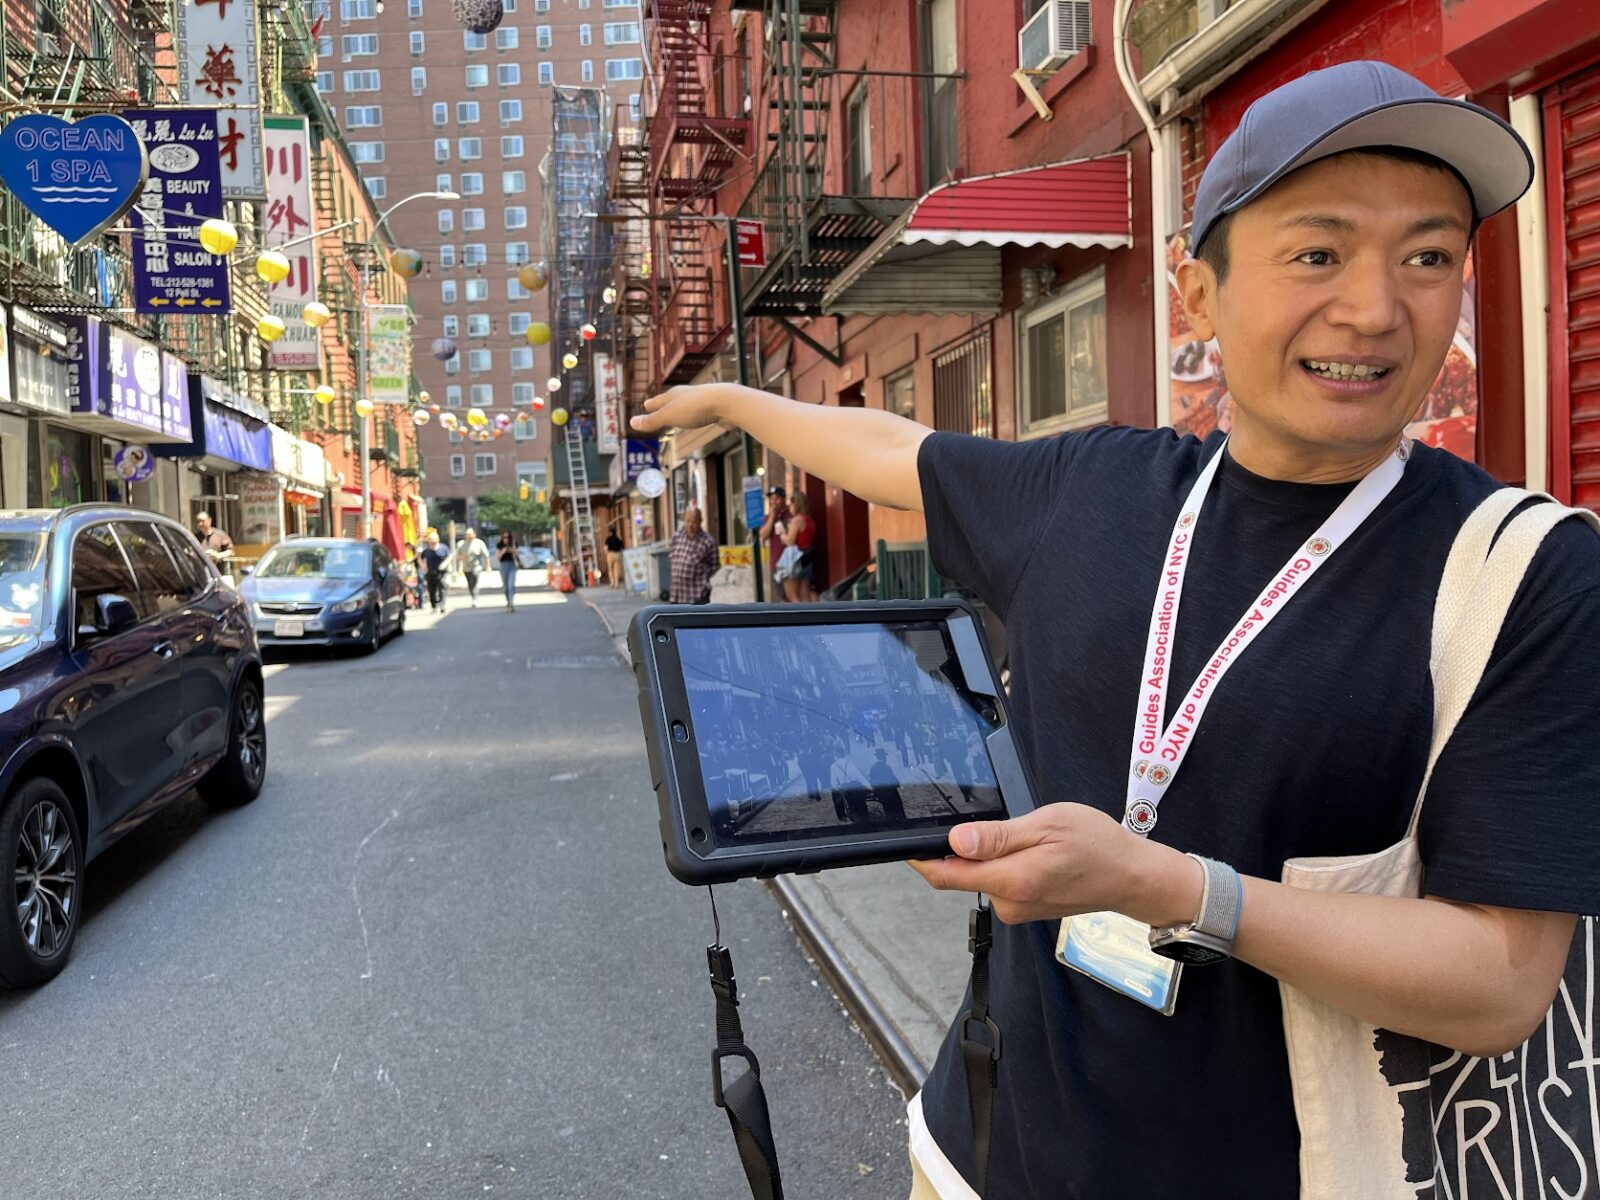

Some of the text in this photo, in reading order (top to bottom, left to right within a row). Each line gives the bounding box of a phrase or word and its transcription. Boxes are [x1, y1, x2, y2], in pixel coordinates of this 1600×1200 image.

[15, 127, 124, 151] OCEAN
[26, 159, 112, 183] 1 SPA
[166, 180, 211, 194] BEAUTY
[184, 202, 194, 216] &
[174, 252, 212, 266] SALON
[273, 303, 305, 319] FAMOU
[282, 325, 317, 342] CHUAN
[1169, 533, 1188, 567] NYC
[1167, 570, 1179, 586] of
[1148, 590, 1175, 689] Association
[1161, 558, 1311, 762] Guides Association of NYC
[1139, 693, 1161, 754] Guides
